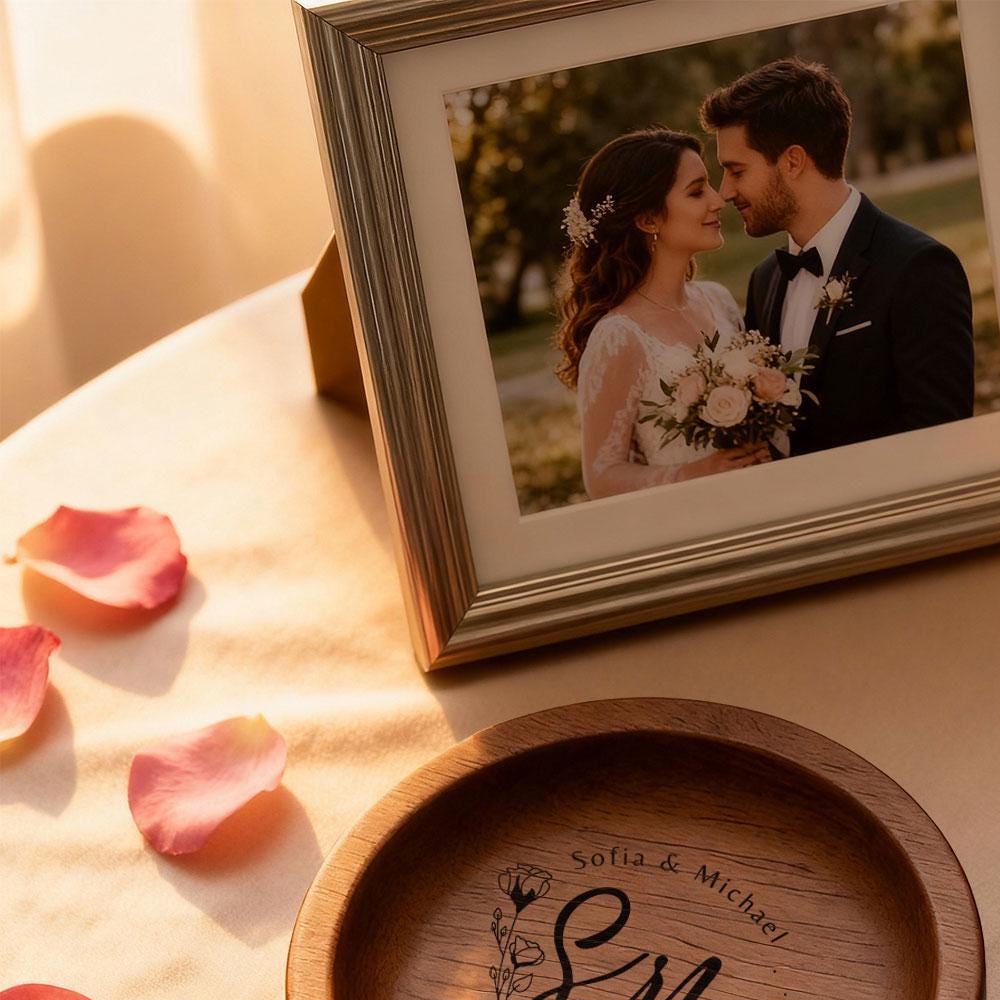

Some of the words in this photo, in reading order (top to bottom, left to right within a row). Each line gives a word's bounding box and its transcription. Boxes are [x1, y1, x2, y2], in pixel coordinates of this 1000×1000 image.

[571, 847, 645, 870] Sofia
[660, 853, 681, 874] &
[694, 864, 789, 943] Michael
